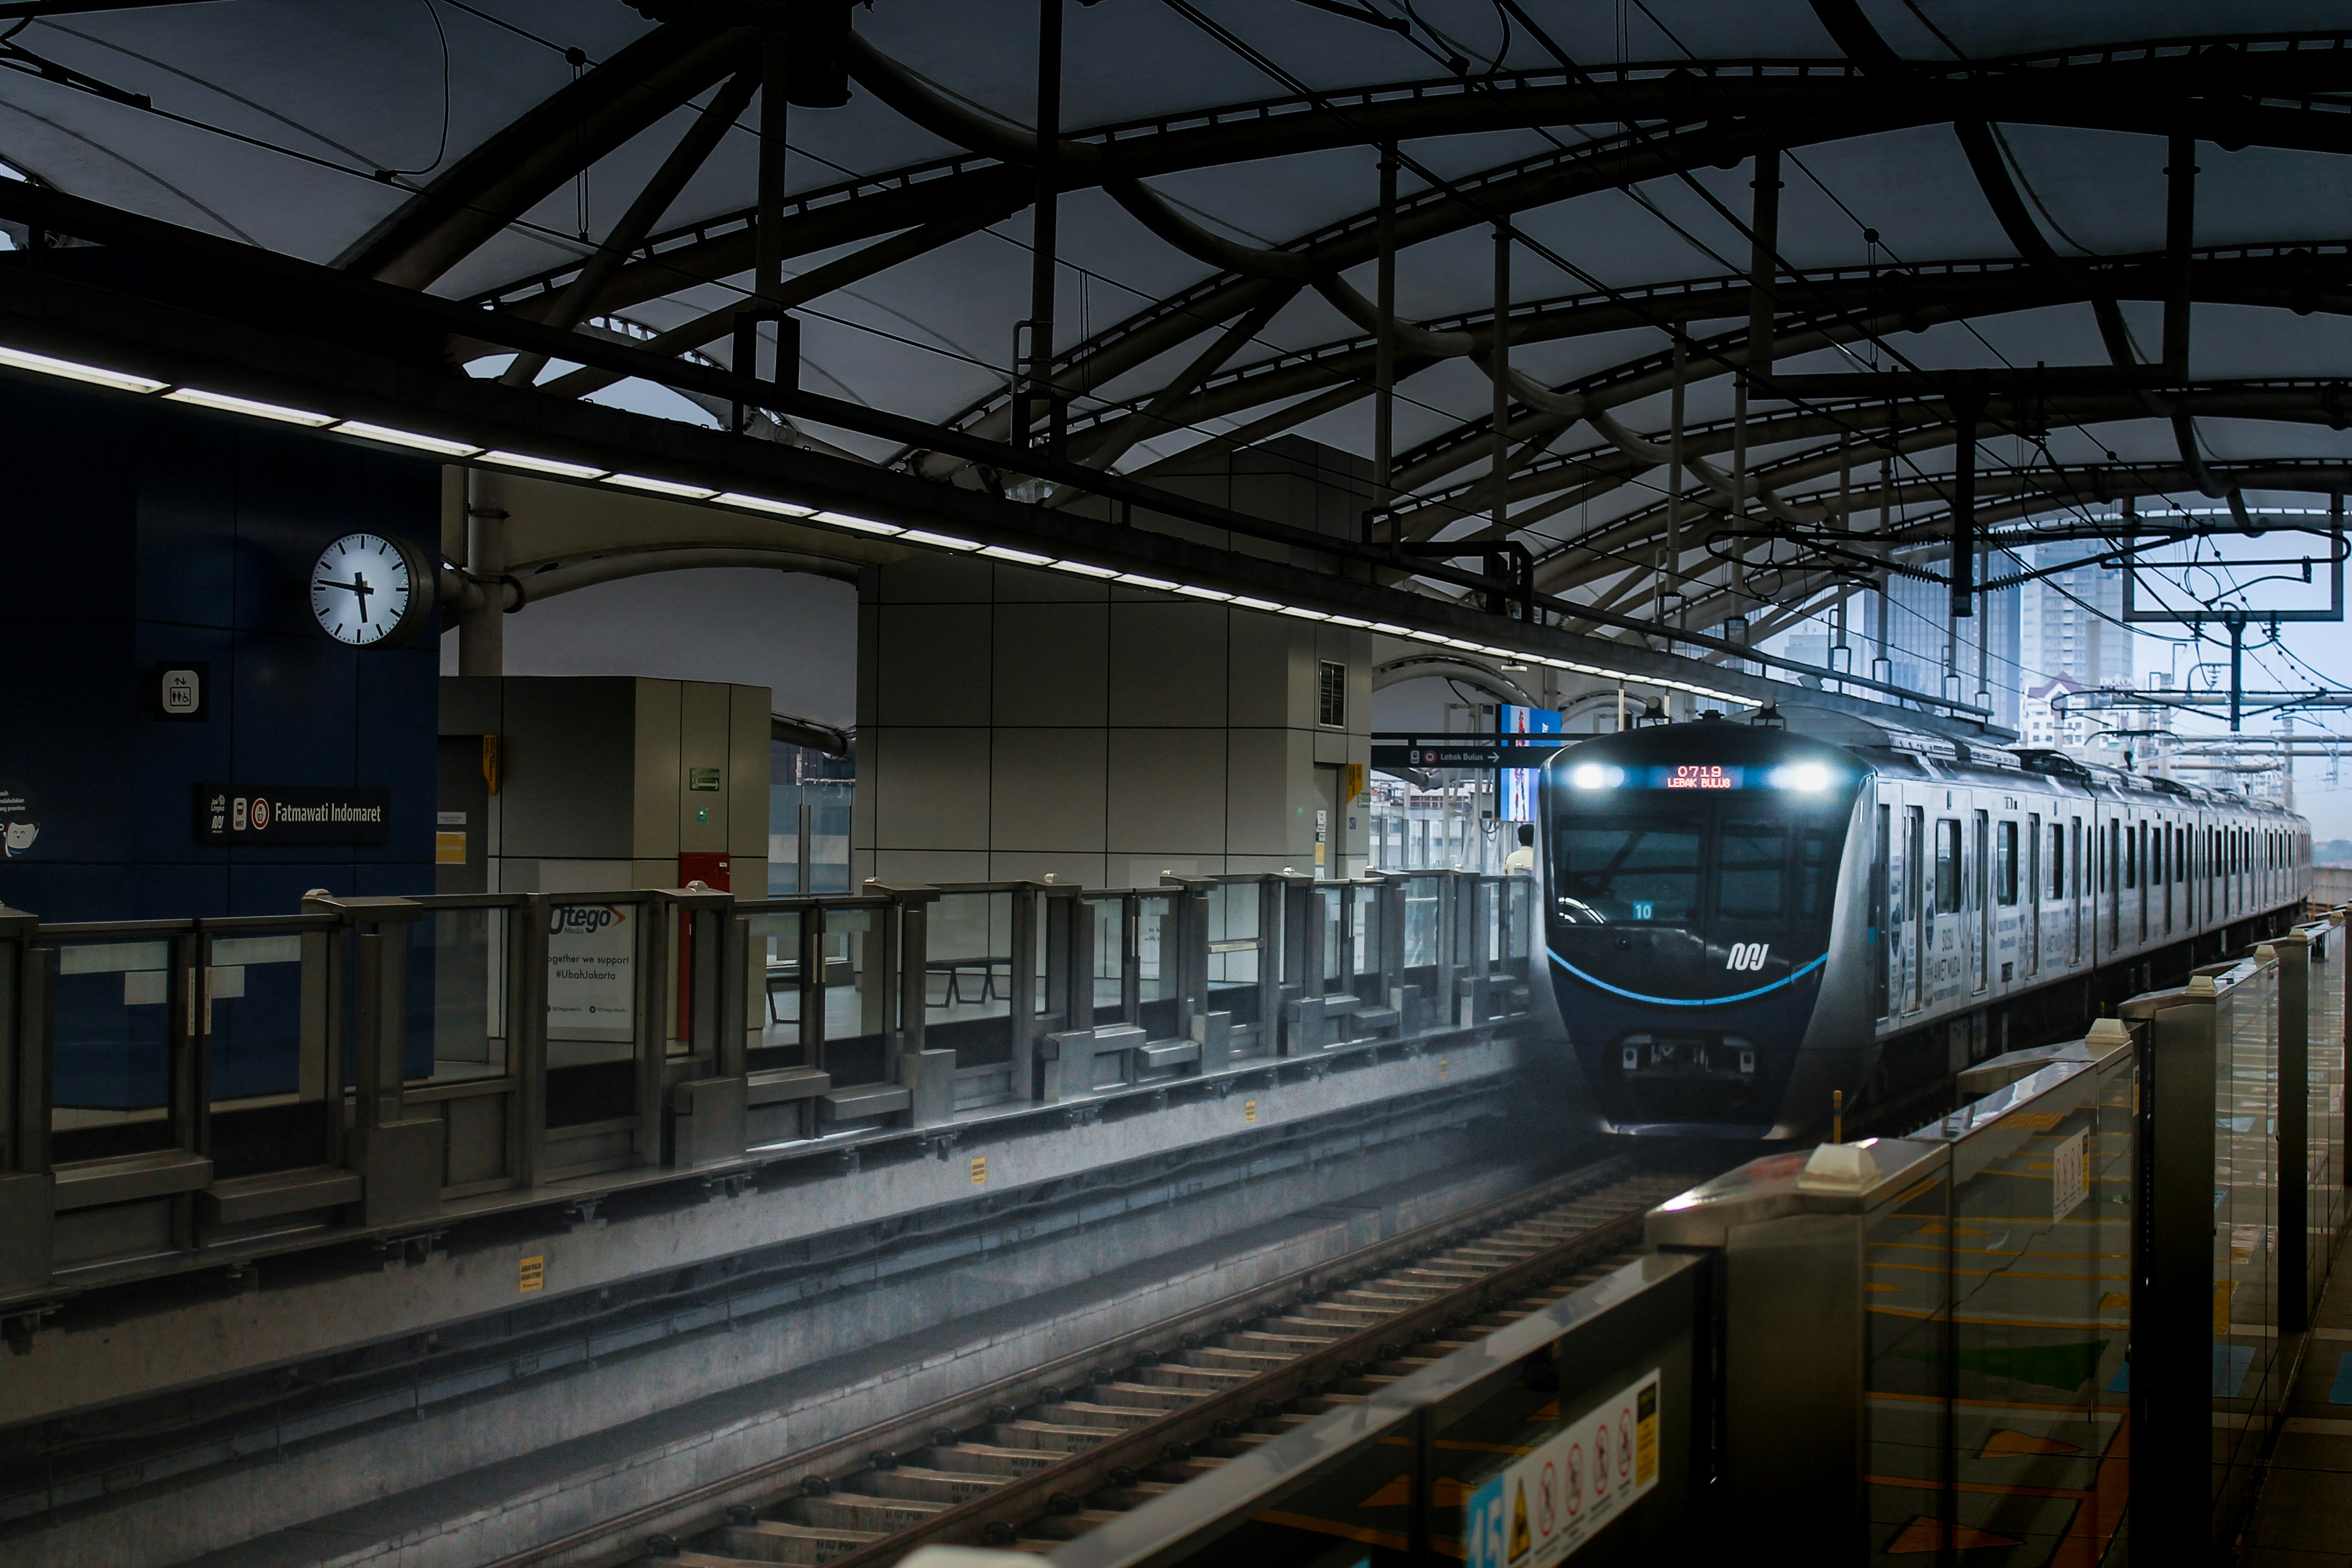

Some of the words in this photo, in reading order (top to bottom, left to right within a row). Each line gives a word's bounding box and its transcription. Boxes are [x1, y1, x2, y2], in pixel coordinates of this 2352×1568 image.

[1678, 766, 1722, 777] 0719
[1668, 778, 1697, 788] LEBAK
[1701, 778, 1731, 788] BULUS
[275, 803, 329, 821] Fatmawati
[331, 803, 381, 822] Indomaret
[1635, 905, 1651, 919] 10
[548, 954, 579, 965] ogether
[597, 956, 629, 966] support
[556, 970, 616, 980] #UbahJakarta
